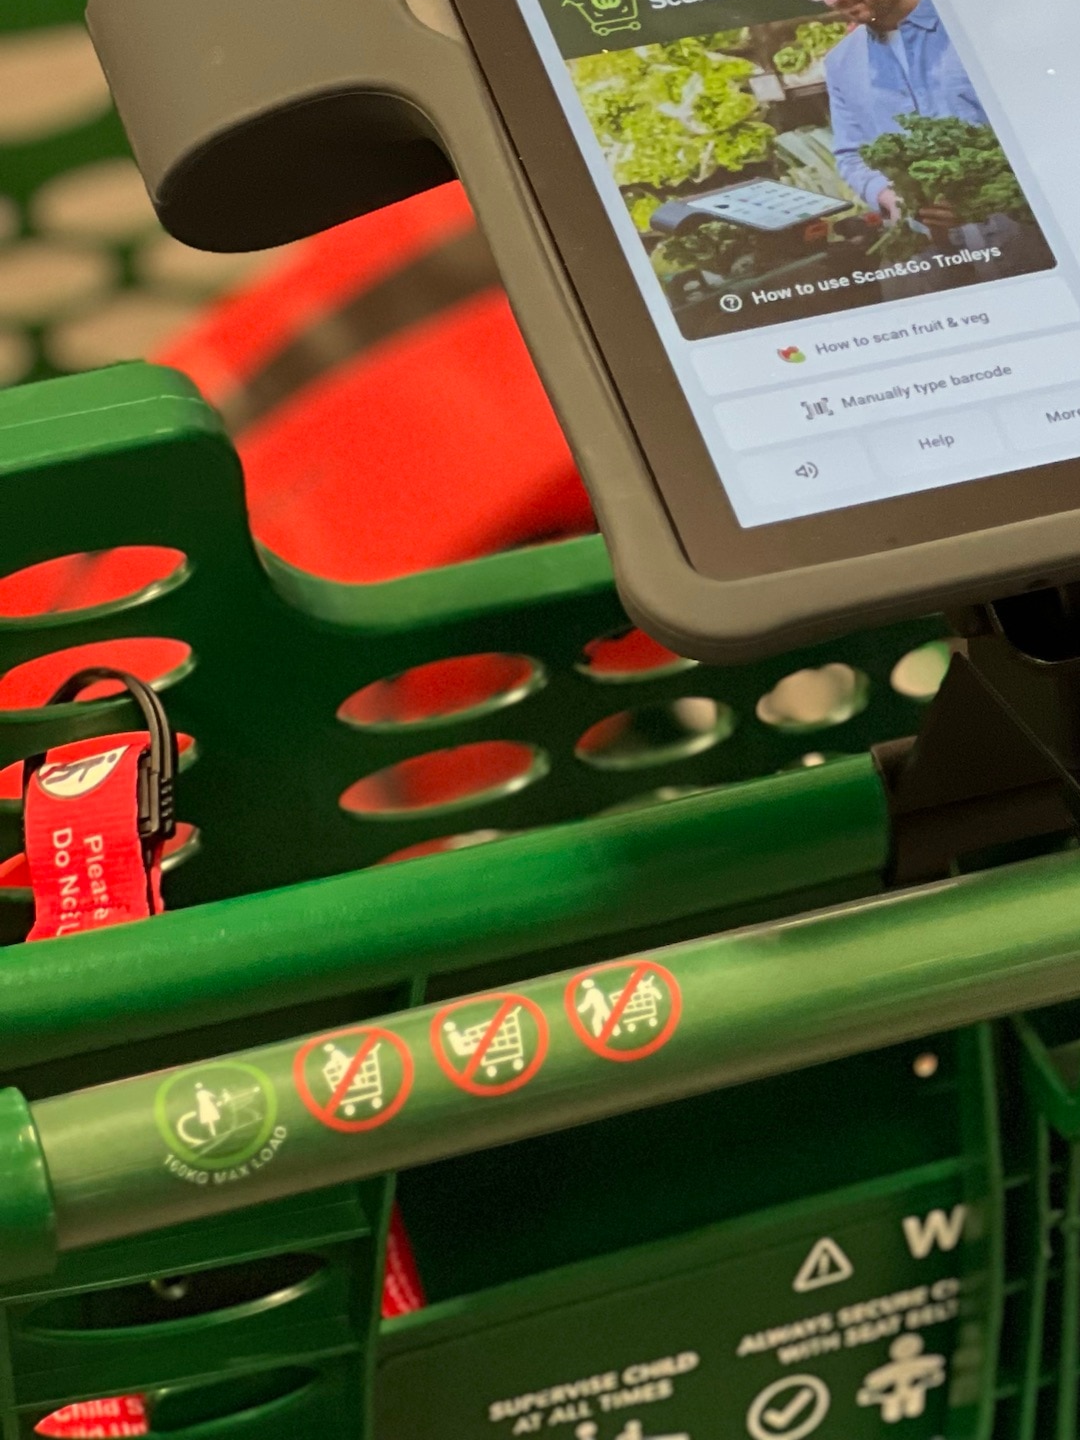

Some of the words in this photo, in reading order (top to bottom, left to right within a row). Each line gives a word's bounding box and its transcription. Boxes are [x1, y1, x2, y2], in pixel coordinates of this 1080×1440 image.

[751, 286, 792, 305] How
[795, 282, 815, 297] to
[818, 275, 850, 292] use
[852, 259, 932, 285] Scan&Go
[932, 244, 1002, 268] Trolleys
[815, 338, 850, 355] How
[853, 335, 870, 348] to
[872, 327, 910, 343] scan
[911, 318, 944, 336] fruit
[946, 316, 959, 328] &
[961, 310, 990, 325] veg
[841, 385, 910, 409] Manually
[913, 378, 948, 396] type
[949, 364, 1013, 386] barcode
[918, 433, 955, 450] Help
[53, 827, 72, 868] Do
[214, 1165, 250, 1185] MAX
[251, 1125, 287, 1169] LOAD
[736, 1312, 834, 1358] ALWAYS
[836, 1285, 928, 1325] SECURE
[777, 1331, 841, 1365] WITH
[844, 1313, 903, 1347] SEAT
[489, 1371, 618, 1422] SUPERVISE
[621, 1351, 700, 1385] CHILD
[513, 1412, 542, 1435] AT
[548, 1400, 592, 1427] ALL
[598, 1378, 673, 1412] TIMES
